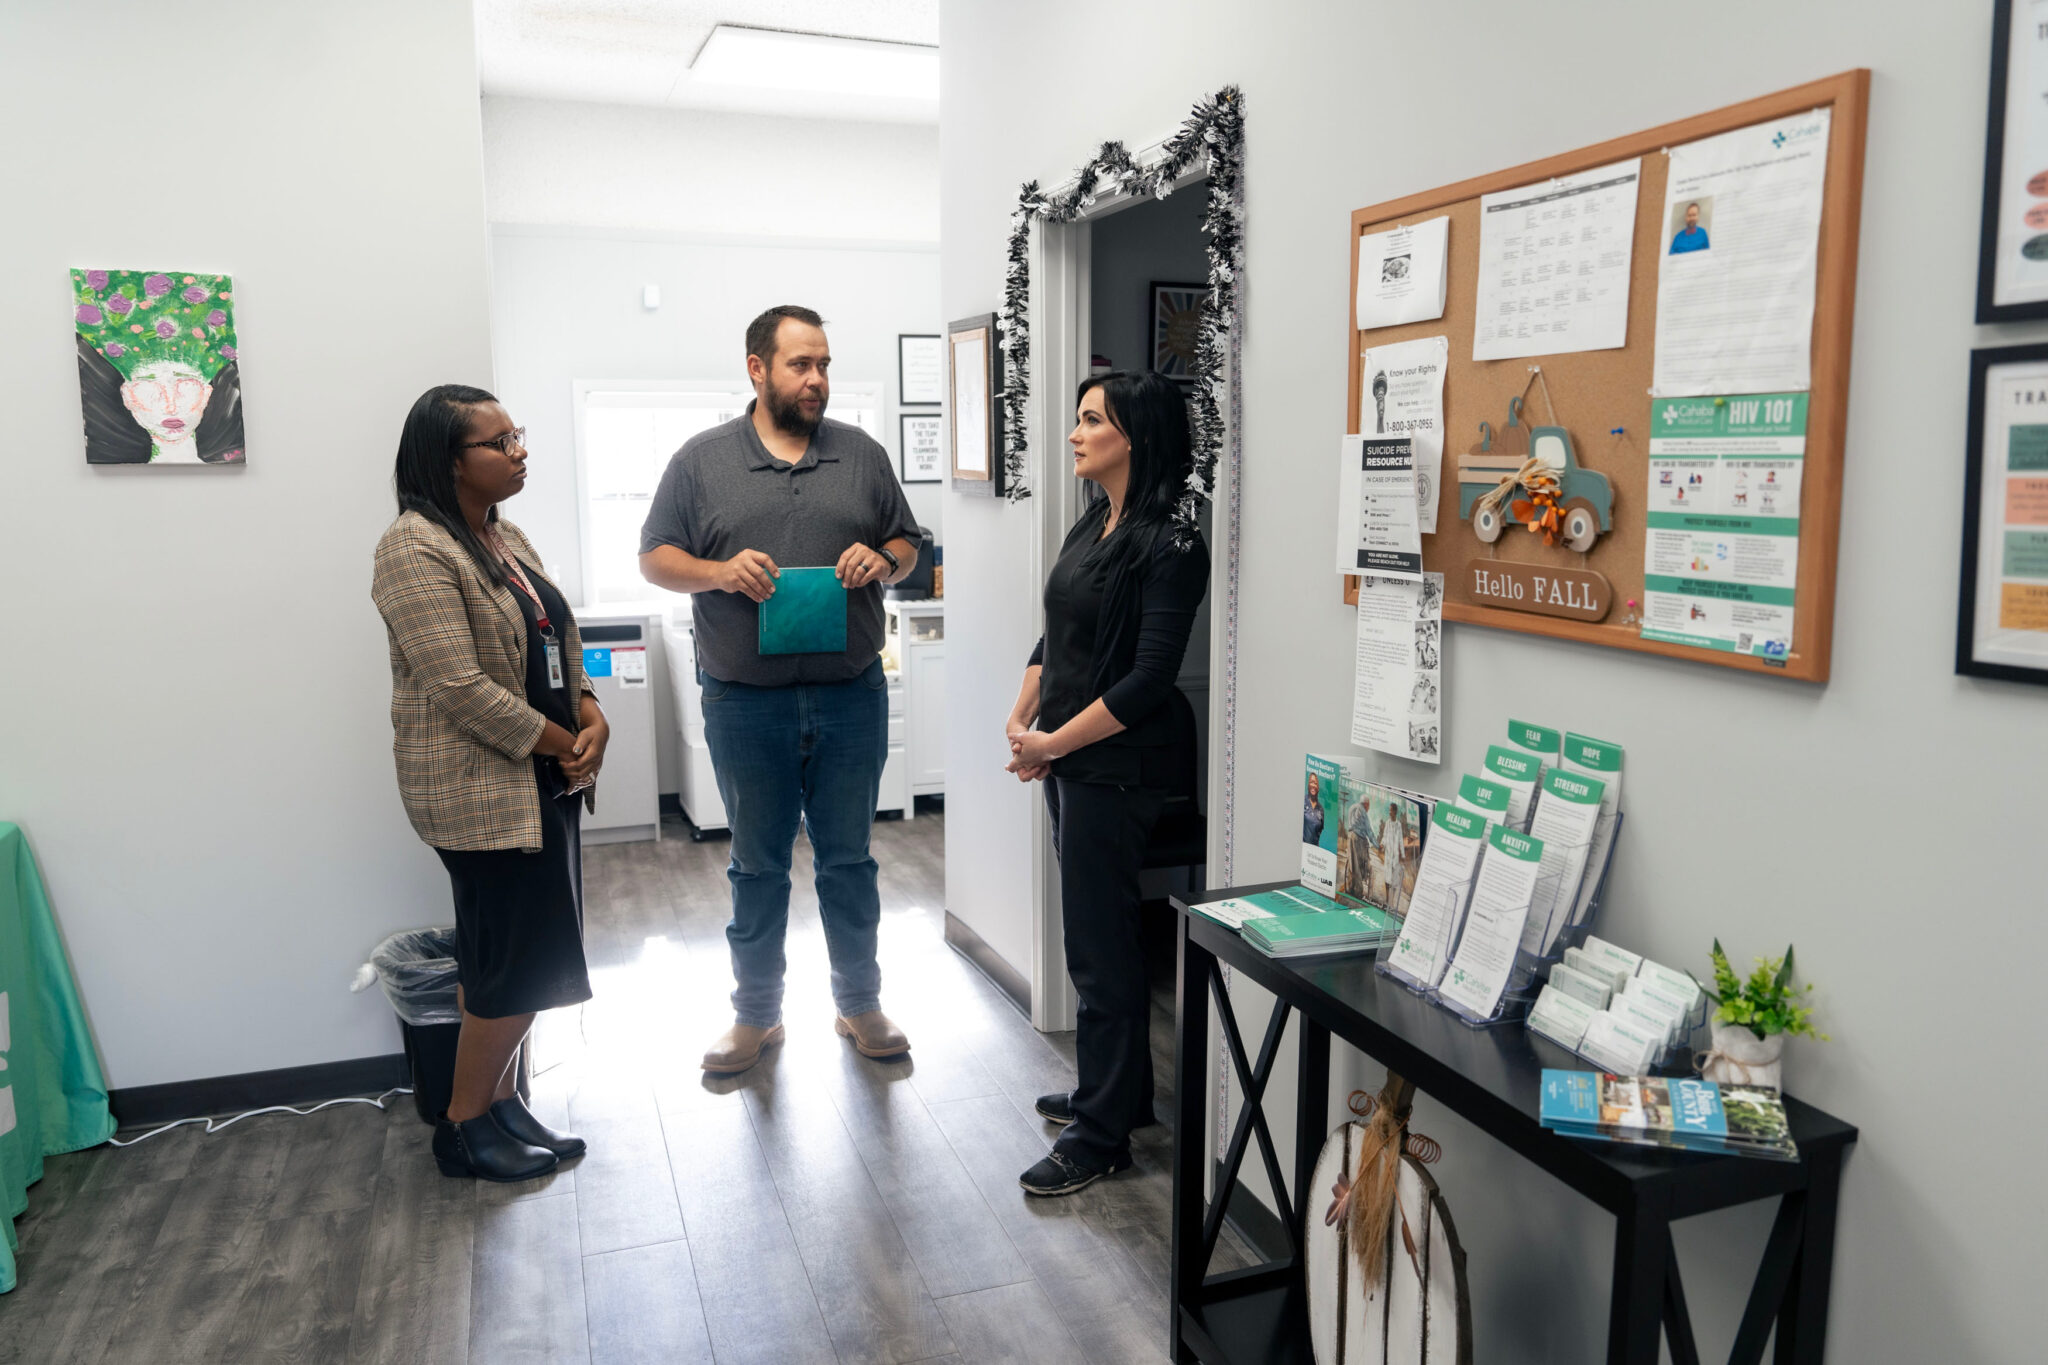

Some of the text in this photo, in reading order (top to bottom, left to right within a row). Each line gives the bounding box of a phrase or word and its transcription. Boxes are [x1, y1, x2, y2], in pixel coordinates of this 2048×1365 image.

[1389, 365, 1437, 377] Know your Rights
[1678, 404, 1714, 417] Cahaba
[1729, 399, 1793, 424] HIV 101
[1367, 446, 1394, 456] SUICIDE
[1366, 457, 1403, 467] RESOURCE
[1474, 569, 1597, 611] Hello FALL
[1525, 729, 1541, 742] FEAR
[1582, 746, 1601, 761] HOPE
[1496, 755, 1528, 773] BLESSING
[1476, 787, 1493, 800] LOVE
[1553, 777, 1589, 797] STRENGTH
[1445, 812, 1472, 830] HEALING
[1501, 833, 1531, 853] ANXIETY
[1320, 877, 1333, 887] UAB
[1678, 1080, 1707, 1130] COUNTY
